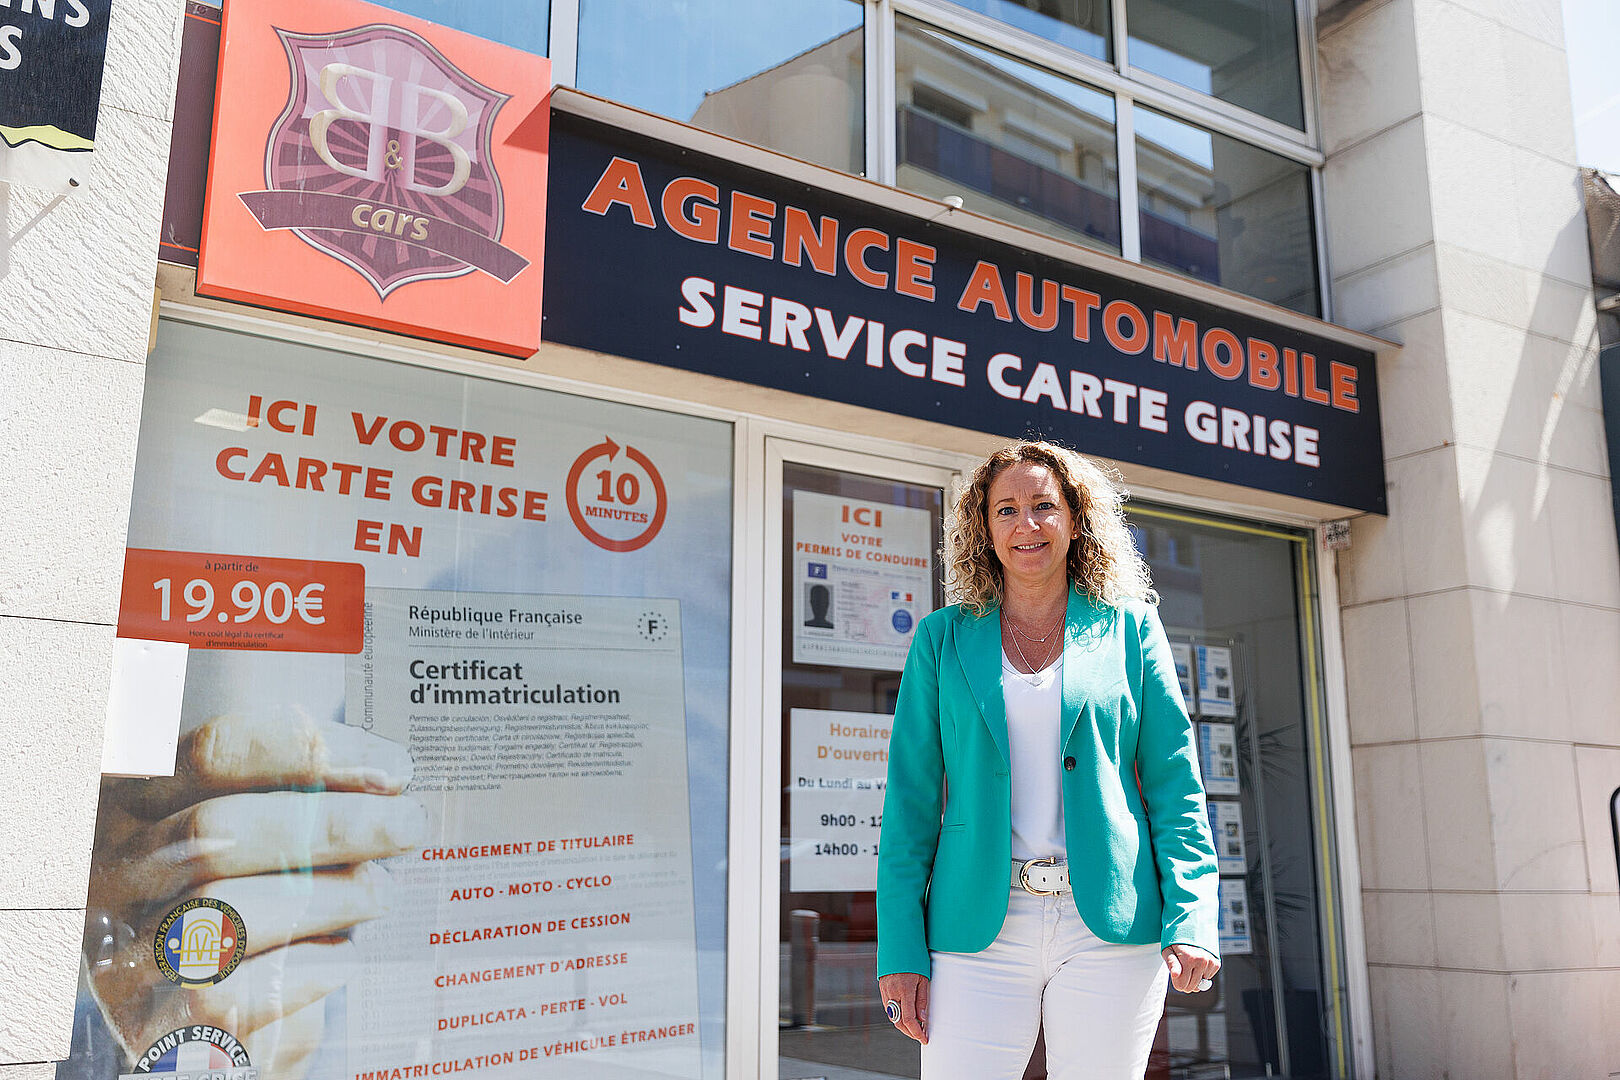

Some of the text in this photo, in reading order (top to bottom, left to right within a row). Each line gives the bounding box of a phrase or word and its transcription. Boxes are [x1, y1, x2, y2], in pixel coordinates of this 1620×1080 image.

[351, 203, 430, 241] cars
[581, 155, 1361, 414] AGENCE AUTOMOBILE
[678, 276, 1321, 468] SERVICE CARTE GRISE
[246, 394, 517, 468] ICI VOTRE
[215, 446, 549, 523] CARTE GRISE
[596, 469, 640, 506] 10
[585, 505, 649, 524] MINUTES
[841, 504, 883, 528] ICI
[353, 519, 424, 559] EN
[841, 532, 883, 548] VOTRE
[204, 559, 260, 573] à partir de
[796, 541, 928, 569] PERMIS DE CONDUIRE
[153, 577, 327, 626] 19.90€
[408, 604, 583, 628] République Française
[408, 625, 462, 639] Ministère
[465, 627, 480, 640] de
[408, 659, 524, 681] Certificat
[408, 682, 621, 705] d'immatriculation
[798, 777, 815, 788] Du
[818, 777, 853, 790] Lundi
[820, 813, 856, 827] 9h00
[421, 842, 532, 861] CHANGEMENT
[537, 840, 556, 853] DE
[560, 833, 635, 851] TITULAIRE
[815, 844, 858, 856] 14h00
[450, 886, 495, 902] AUTO
[508, 880, 553, 897] MOTO
[566, 875, 612, 891] CYCLO
[429, 922, 543, 945] DÉCLARATION
[547, 919, 566, 933] DE
[571, 912, 631, 929] CESSION
[434, 952, 629, 988] CHANGEMENT D'ADRESSE
[438, 1007, 527, 1031] DUPLICATA
[541, 998, 587, 1016] PERTE
[598, 993, 628, 1008] VOL
[138, 1025, 248, 1073] POINT SERVICE
[519, 1047, 539, 1062] DE
[543, 1035, 617, 1057] VÉHICULE
[621, 1023, 696, 1046] ÉTRANGER
